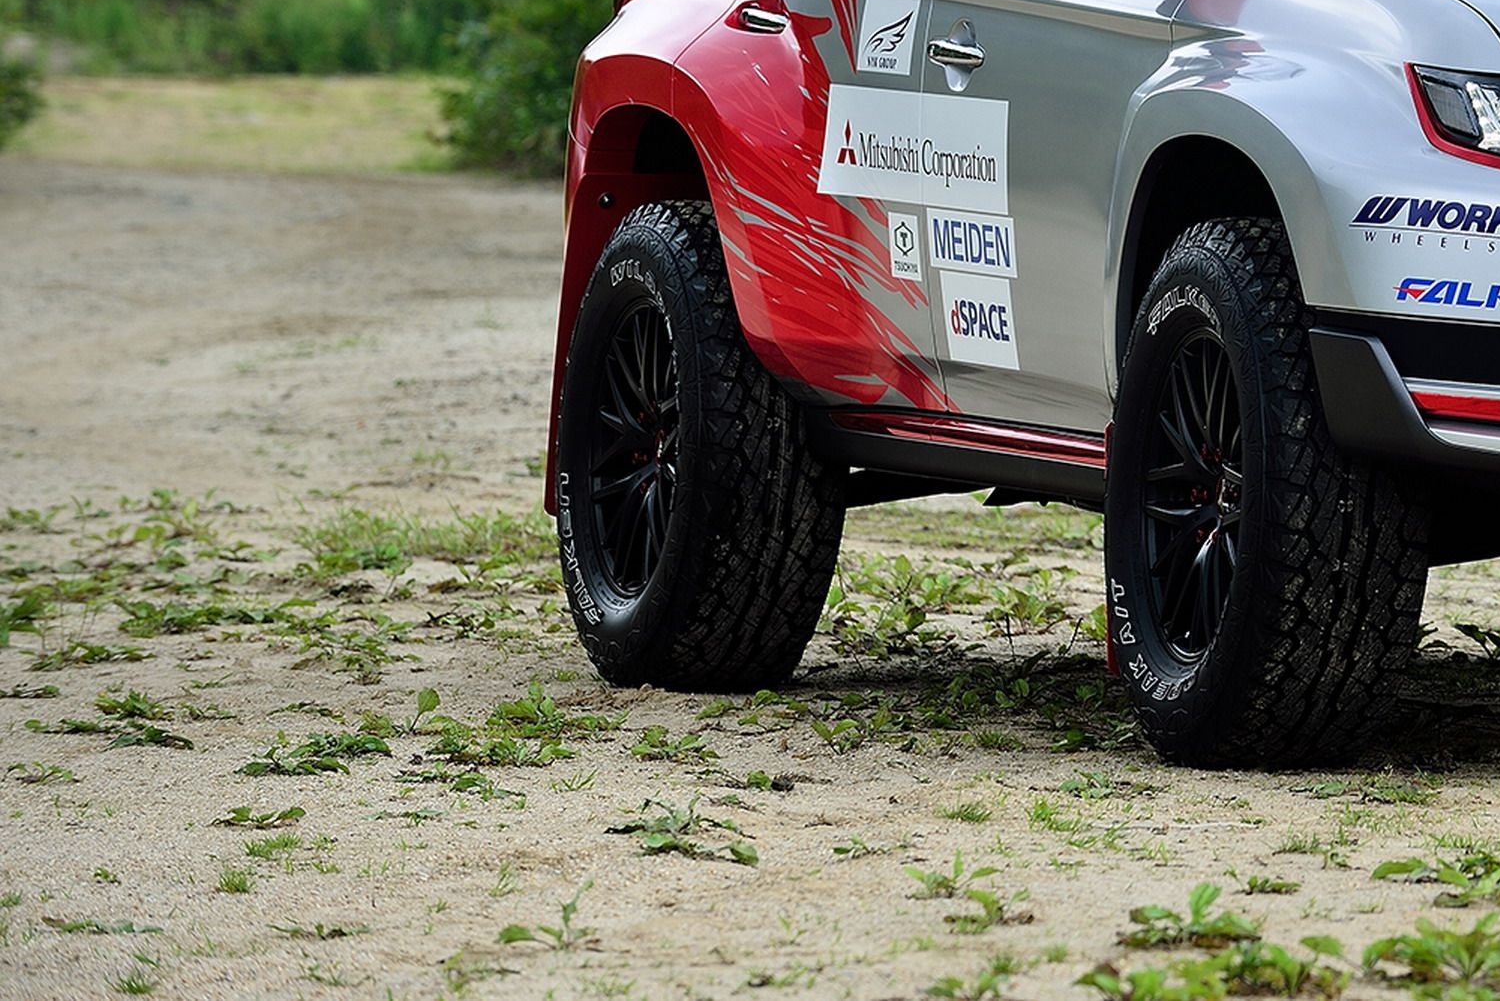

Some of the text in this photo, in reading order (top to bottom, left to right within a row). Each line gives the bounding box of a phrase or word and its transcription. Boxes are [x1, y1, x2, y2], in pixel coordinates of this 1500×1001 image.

[857, 132, 997, 187] Mitsubishi Corporation
[932, 218, 1012, 268] MEIDEN
[1363, 230, 1497, 253] WHEELS
[950, 299, 1010, 343] dSPACE
